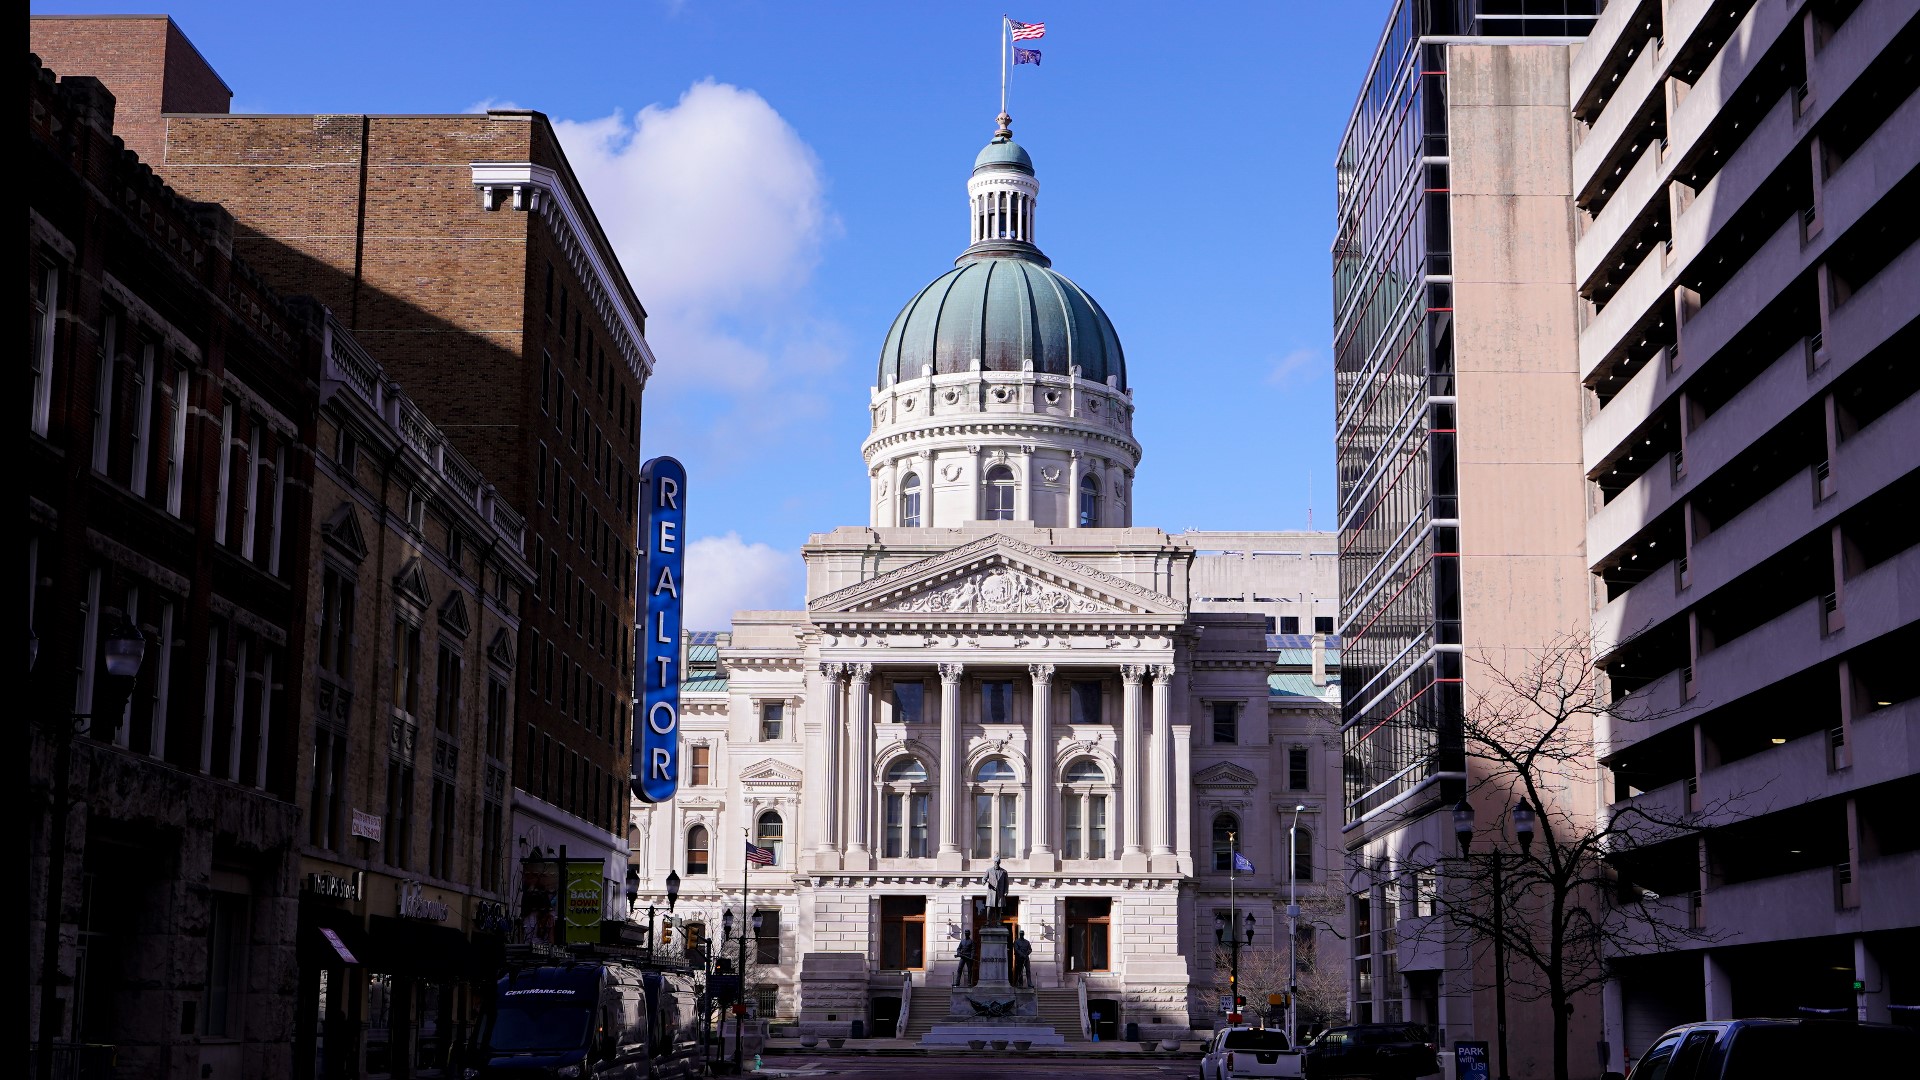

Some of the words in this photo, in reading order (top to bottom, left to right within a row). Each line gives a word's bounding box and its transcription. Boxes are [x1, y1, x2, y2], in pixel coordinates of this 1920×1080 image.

[649, 476, 678, 780] REALTOR
[326, 875, 339, 897] UPS
[570, 890, 599, 899] BACK
[570, 899, 599, 907] DOWN
[1458, 1047, 1484, 1055] PARK
[1470, 1062, 1486, 1070] US!
